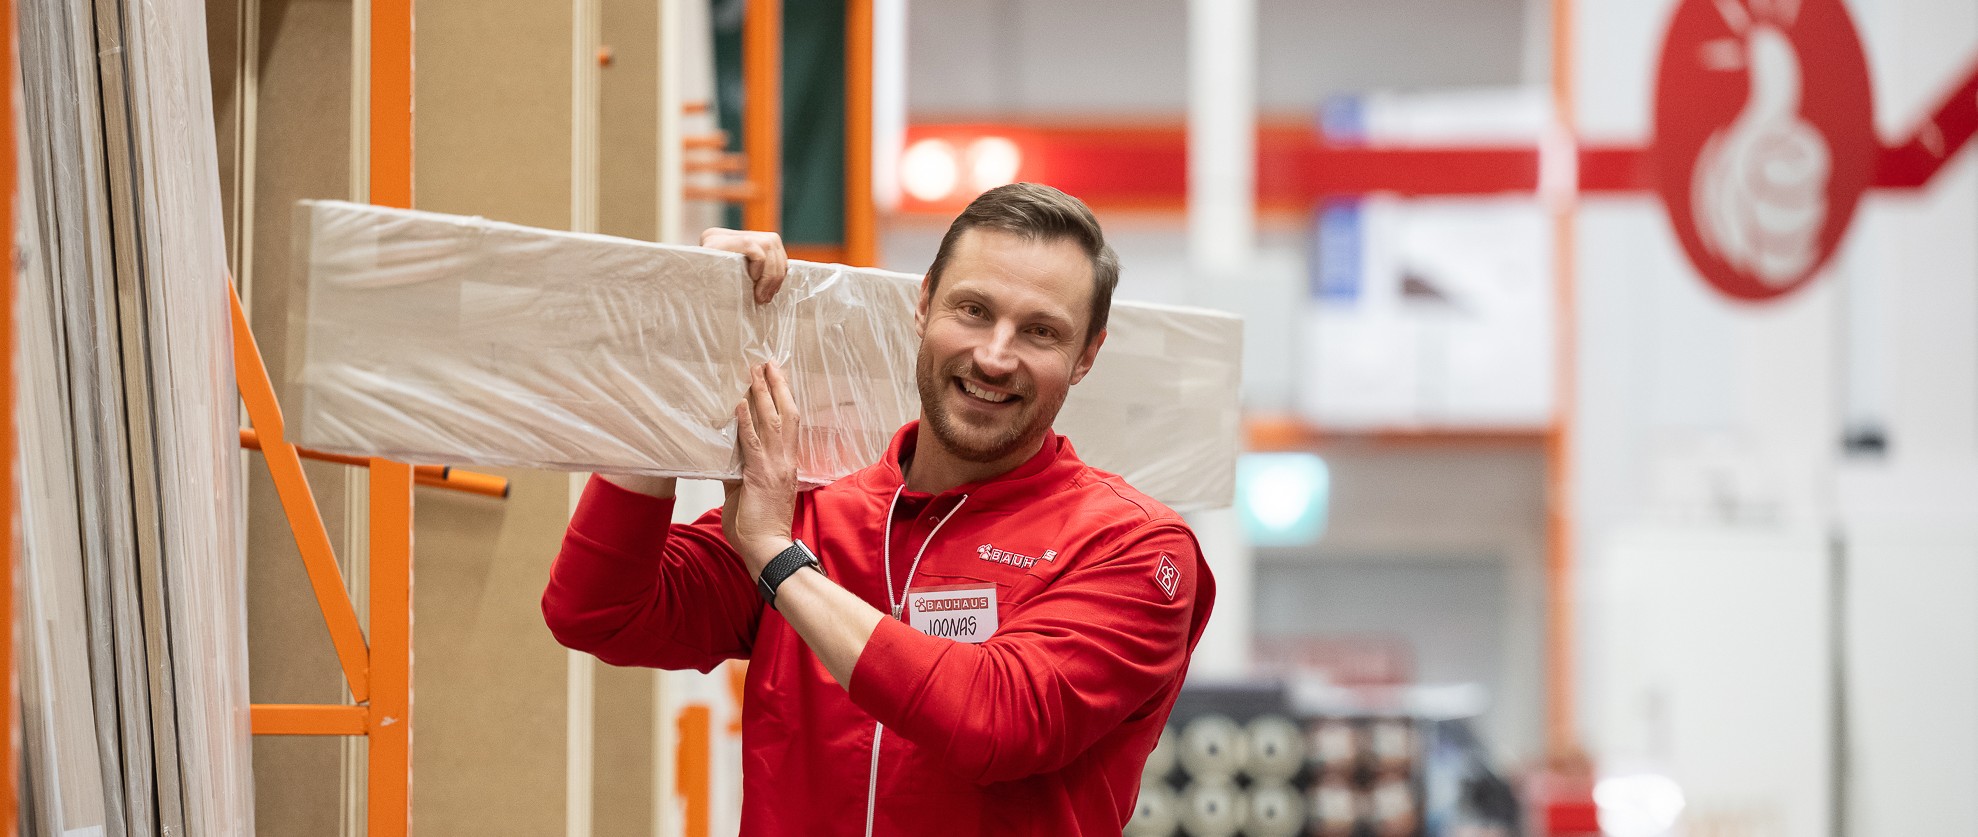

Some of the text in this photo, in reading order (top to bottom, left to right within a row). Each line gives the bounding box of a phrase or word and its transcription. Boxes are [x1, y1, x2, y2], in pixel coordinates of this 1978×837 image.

[992, 549, 1057, 567] BAUHS
[926, 598, 988, 610] BAUHAUS
[924, 616, 977, 637] JOONAS
